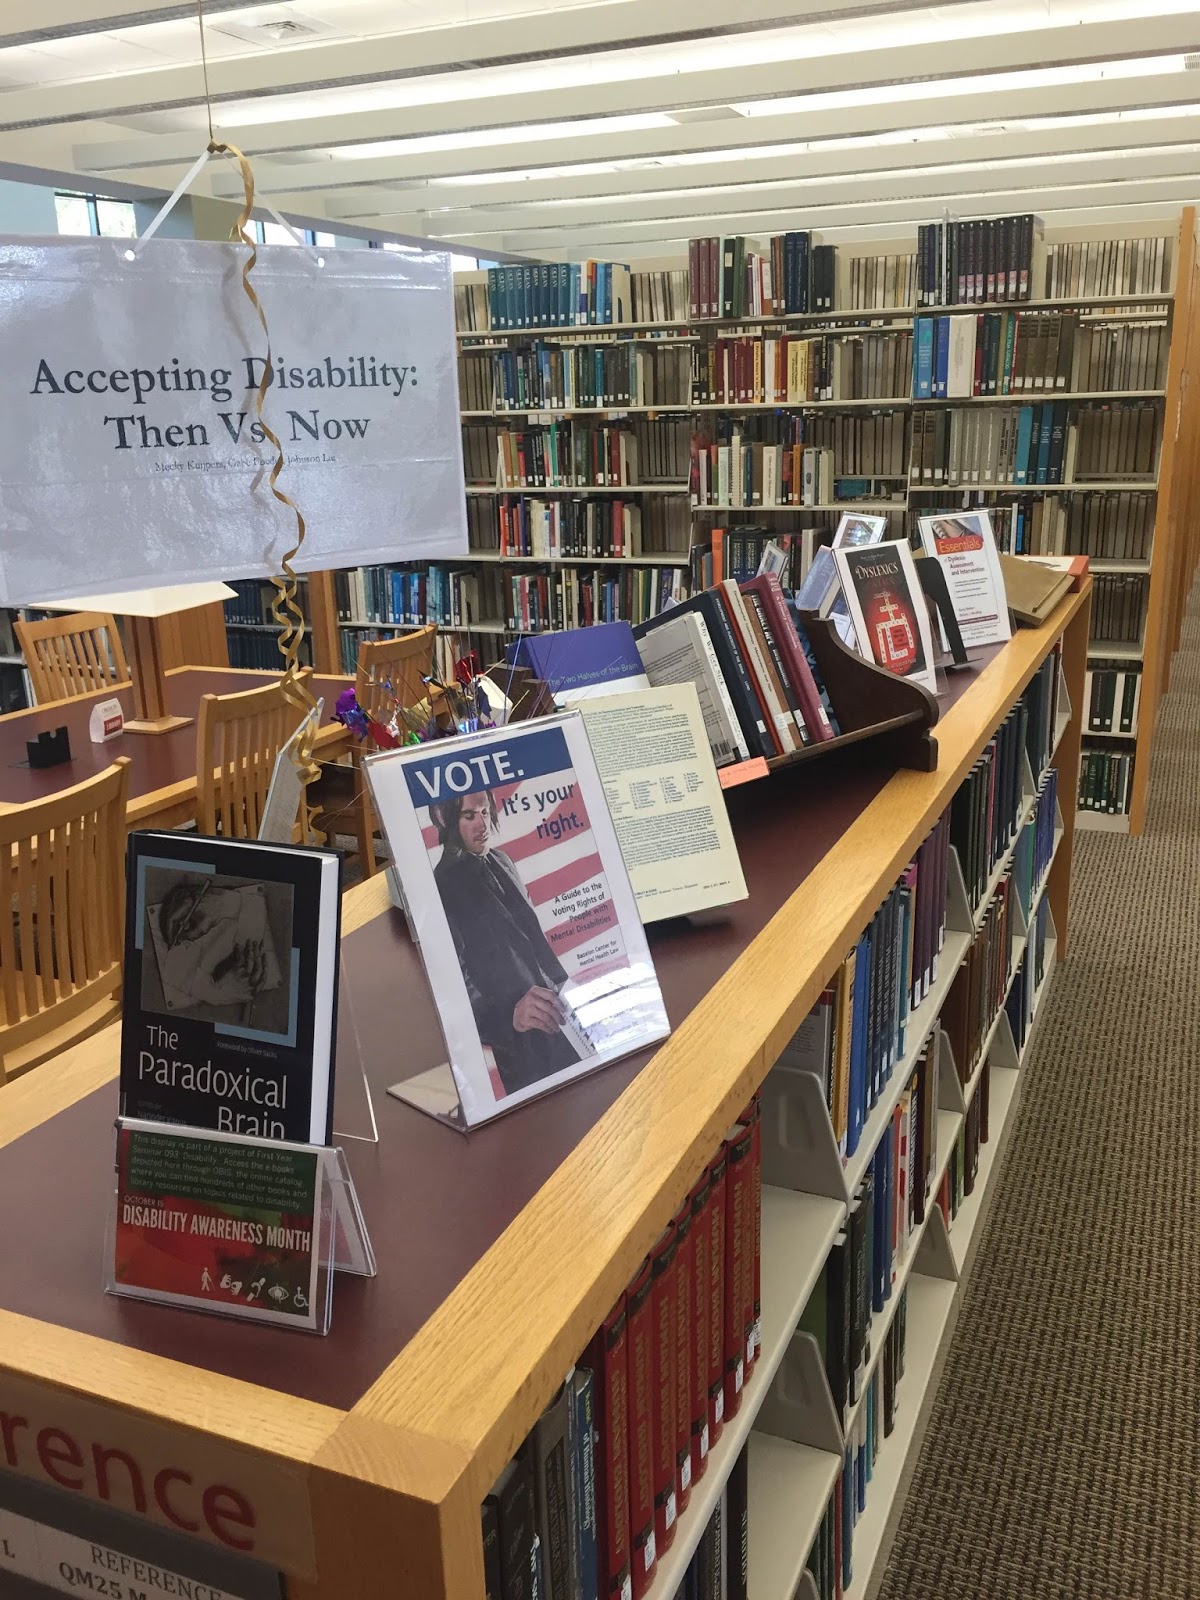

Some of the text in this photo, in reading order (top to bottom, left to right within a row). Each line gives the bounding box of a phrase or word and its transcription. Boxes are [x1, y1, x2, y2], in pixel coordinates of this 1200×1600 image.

[30, 356, 417, 404] Accepting Disability:
[104, 415, 210, 449] Then
[289, 409, 370, 442] Now
[939, 539, 981, 552] Essentials
[855, 562, 899, 580] DYSLEXICS
[950, 561, 974, 569] Assessment
[960, 567, 985, 575] Intervention
[706, 641, 713, 651] We
[547, 661, 639, 689] The Two Halves of the Brain
[415, 751, 526, 800] VOTE.
[500, 792, 531, 818] It's
[535, 783, 576, 814] your
[536, 813, 584, 842] right.
[552, 892, 605, 917] Voting Rights of
[554, 882, 602, 904] A Guide to the
[569, 904, 608, 923] People with
[551, 916, 612, 942] Mental Disabilities
[580, 948, 619, 966] Mental Health Law
[595, 944, 609, 953] Center
[146, 1025, 178, 1050] The
[241, 1046, 247, 1054] by
[247, 1046, 262, 1055] Oliver
[263, 1049, 277, 1058] Sacks
[139, 1051, 287, 1109] Paradoxical
[217, 1106, 285, 1139] Brain
[132, 1146, 162, 1155] Seminar
[223, 1158, 249, 1168] Access
[252, 1161, 263, 1169] the
[134, 1135, 148, 1143] This
[151, 1137, 176, 1147] display
[186, 1142, 202, 1151] part
[220, 1147, 245, 1157] project
[247, 1149, 255, 1157] of
[131, 1156, 162, 1167] depicted
[183, 1163, 211, 1175] through
[236, 1171, 248, 1179] the
[131, 1168, 152, 1176] where
[184, 1174, 198, 1182] find
[200, 1176, 235, 1188] hundreds
[246, 1183, 265, 1192] other
[268, 1187, 290, 1195] books
[131, 1177, 154, 1188] library
[155, 1182, 190, 1192] resources
[204, 1188, 226, 1198] topics
[228, 1192, 254, 1202] related
[124, 1195, 157, 1206] OCTOBER
[123, 1205, 310, 1252] DISABILITY AWARENESS MONTH
[706, 1206, 722, 1285] HUMAN
[583, 1443, 592, 1485] Human
[59, 1562, 122, 1600] QM25
[91, 1544, 222, 1600] REFERENCE
